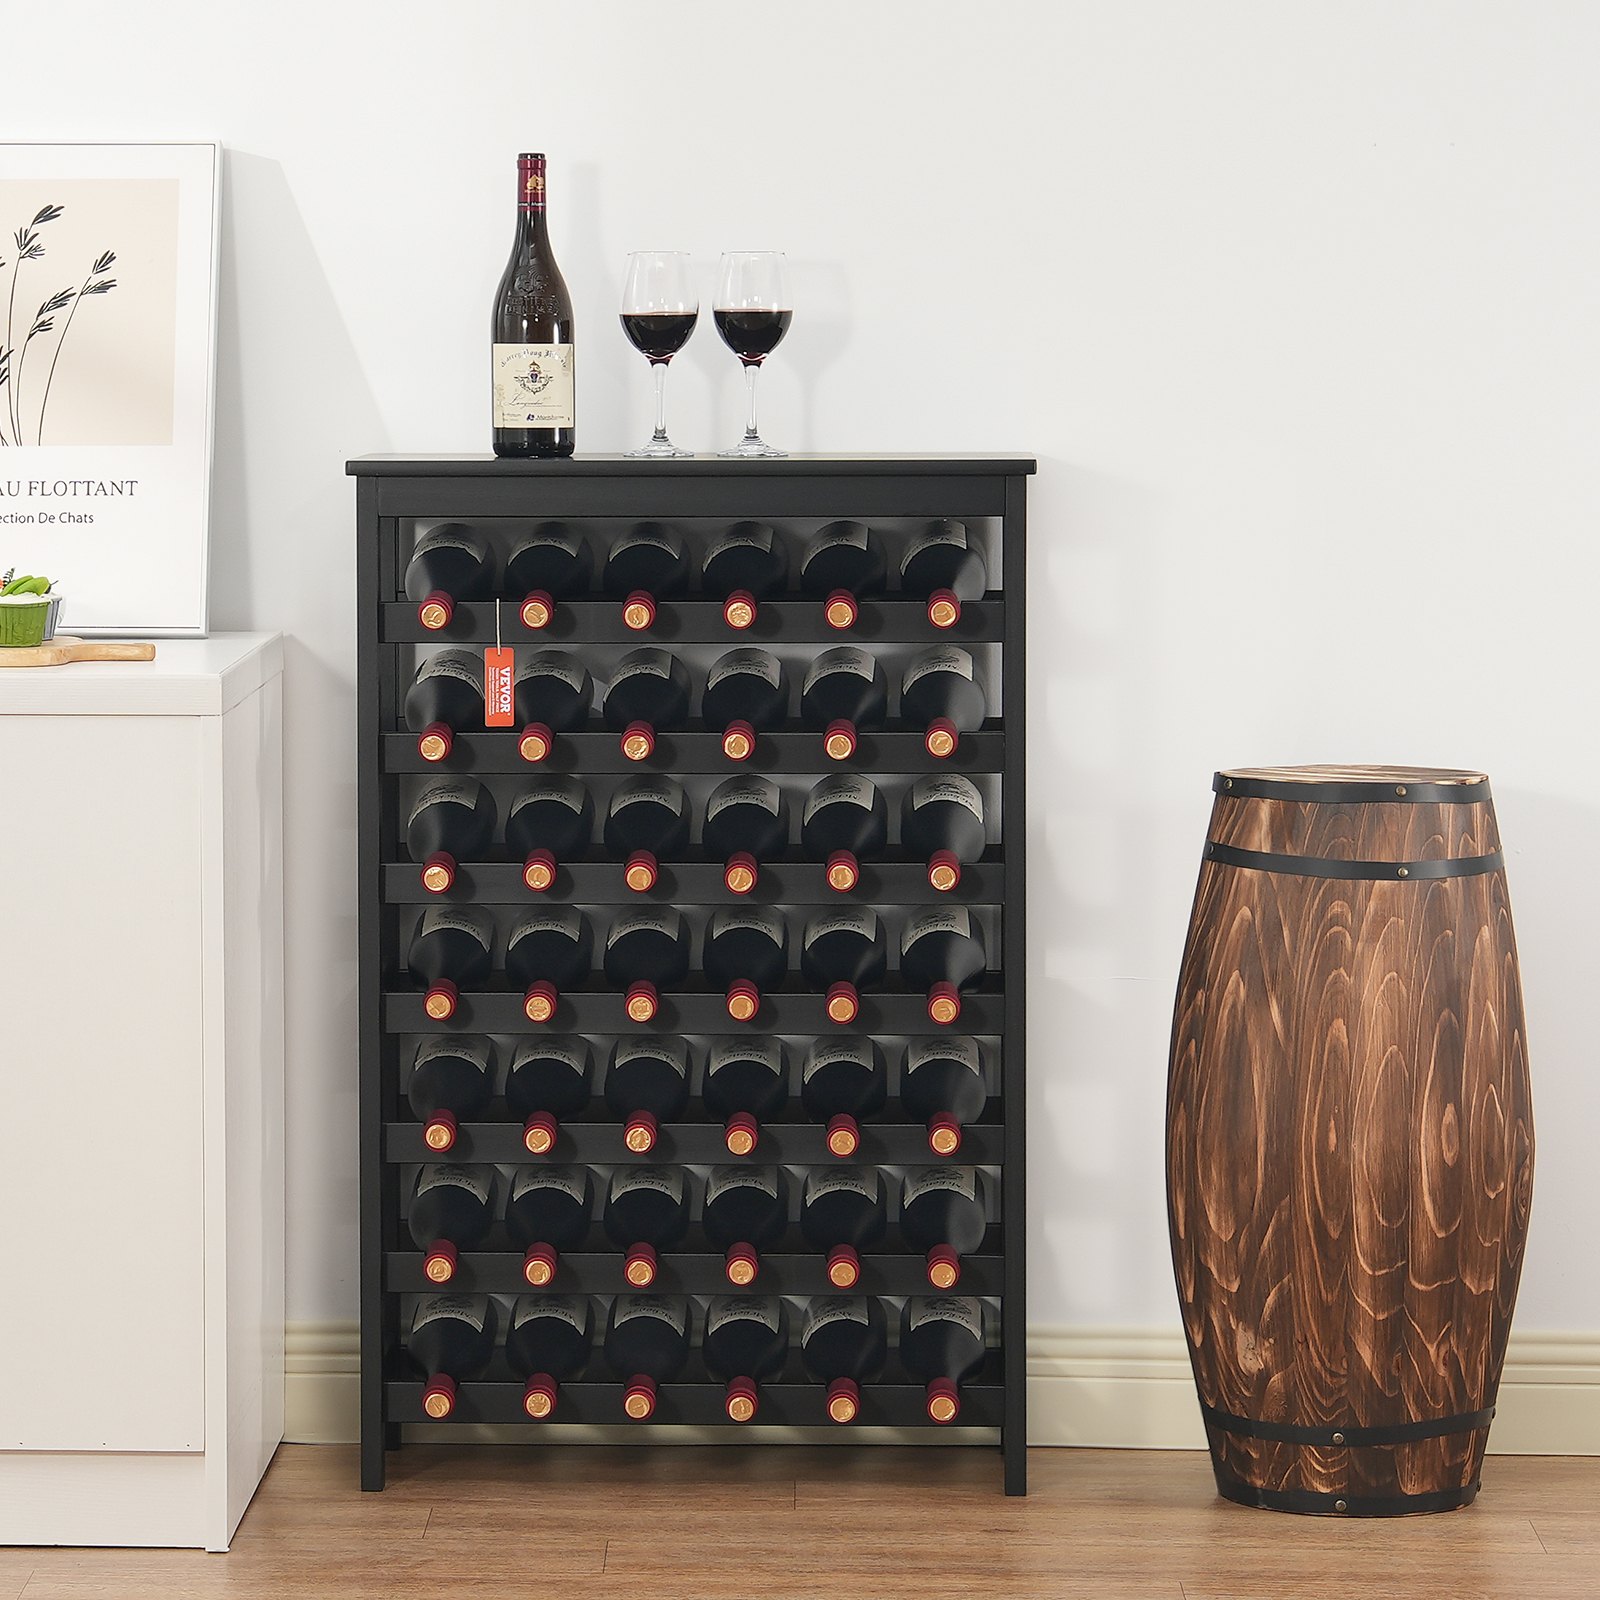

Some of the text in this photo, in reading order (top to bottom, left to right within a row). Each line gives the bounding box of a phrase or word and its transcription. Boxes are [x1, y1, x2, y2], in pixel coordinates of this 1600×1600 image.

[27, 480, 139, 497] FLOTTANT
[38, 512, 56, 524] De
[58, 511, 95, 524] Chats
[500, 666, 511, 713] VEVOR
